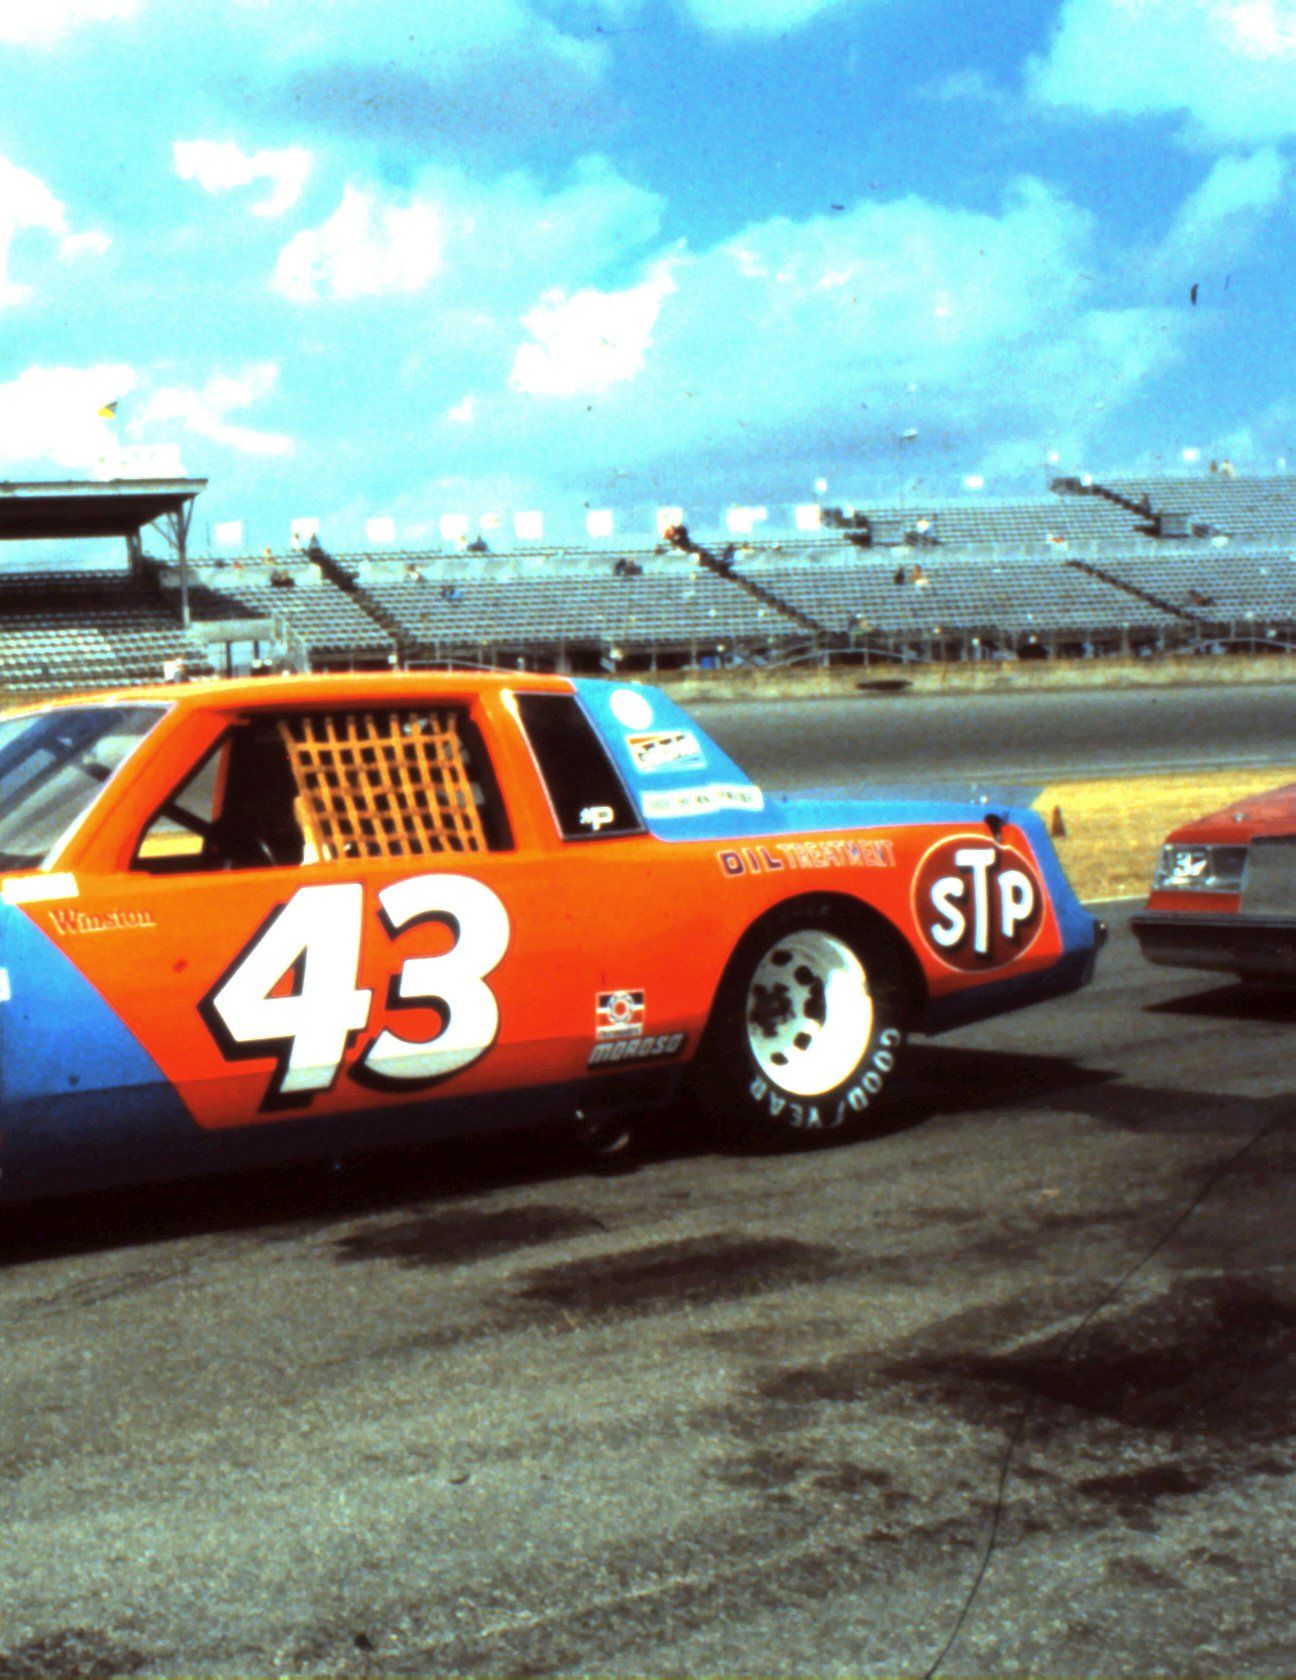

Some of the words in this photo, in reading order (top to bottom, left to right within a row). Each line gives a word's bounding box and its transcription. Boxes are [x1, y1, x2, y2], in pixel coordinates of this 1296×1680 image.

[716, 846, 786, 878] OIL
[930, 848, 1034, 955] STP
[48, 908, 157, 936] Winston
[204, 872, 511, 1106] 43
[588, 1033, 684, 1065] MOROSO
